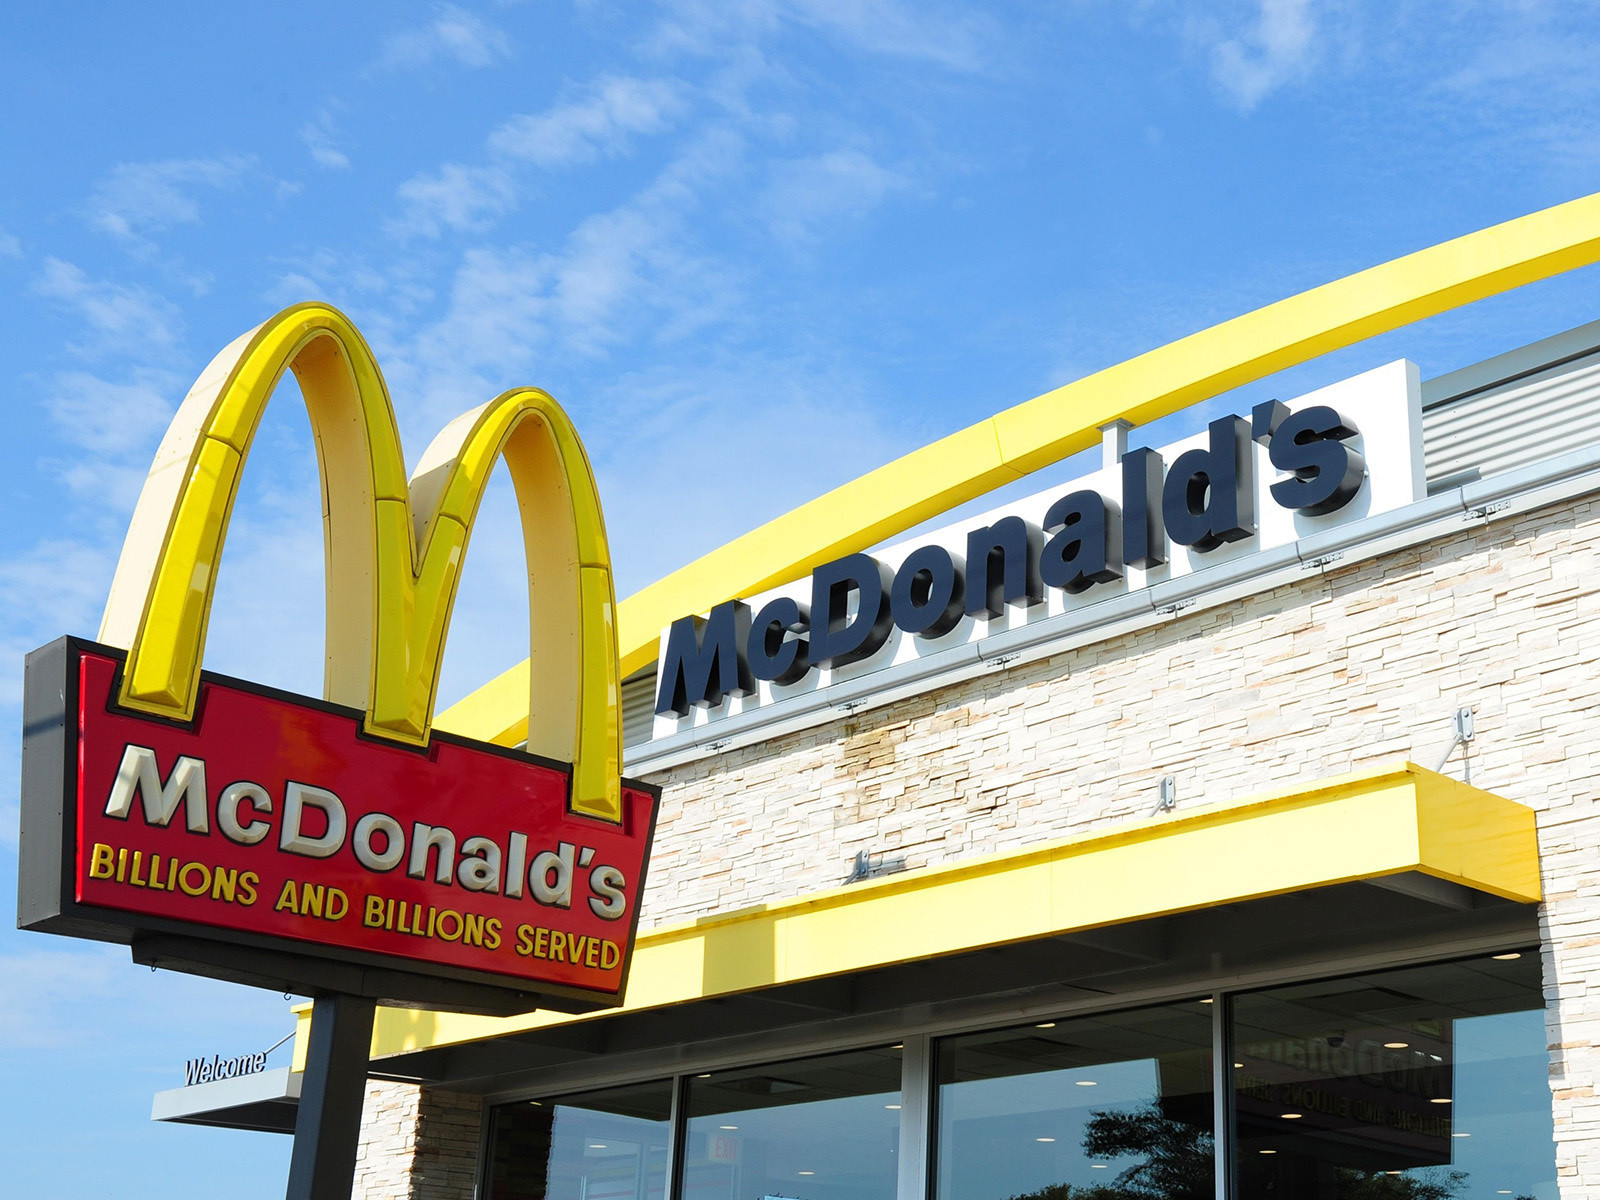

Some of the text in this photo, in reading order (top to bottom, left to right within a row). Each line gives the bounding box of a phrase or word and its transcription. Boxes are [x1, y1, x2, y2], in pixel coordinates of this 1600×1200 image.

[655, 399, 1364, 719] McDonald's
[89, 843, 621, 971] BILLIONS AND BILLIONS SERVED
[104, 743, 627, 921] McDonald's
[184, 1052, 267, 1087] Welcome
